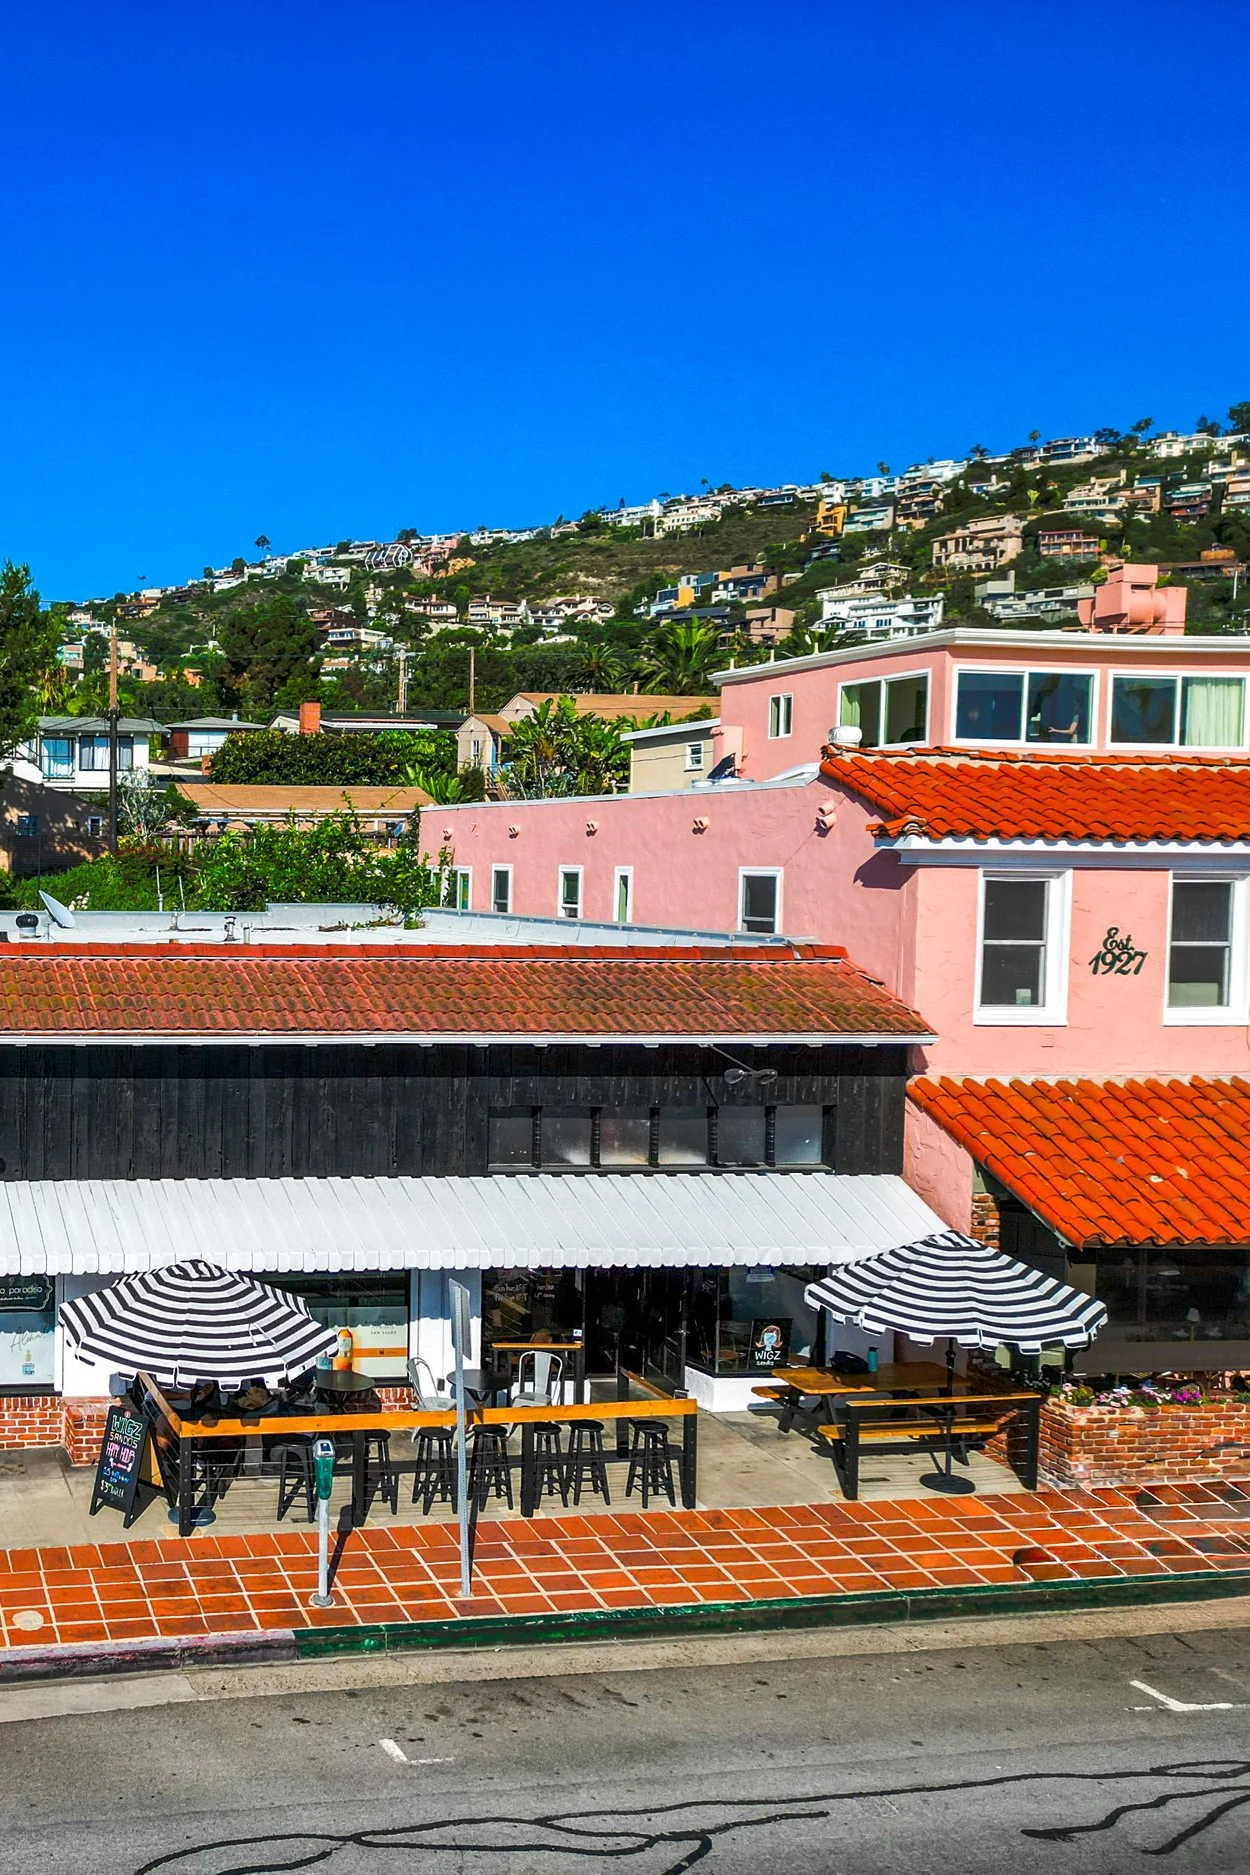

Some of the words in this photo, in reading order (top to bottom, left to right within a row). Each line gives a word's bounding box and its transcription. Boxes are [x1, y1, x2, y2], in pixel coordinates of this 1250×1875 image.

[1088, 950, 1148, 975] 1927
[754, 1350, 782, 1361] WIGZ
[111, 1414, 143, 1441] WIGZ
